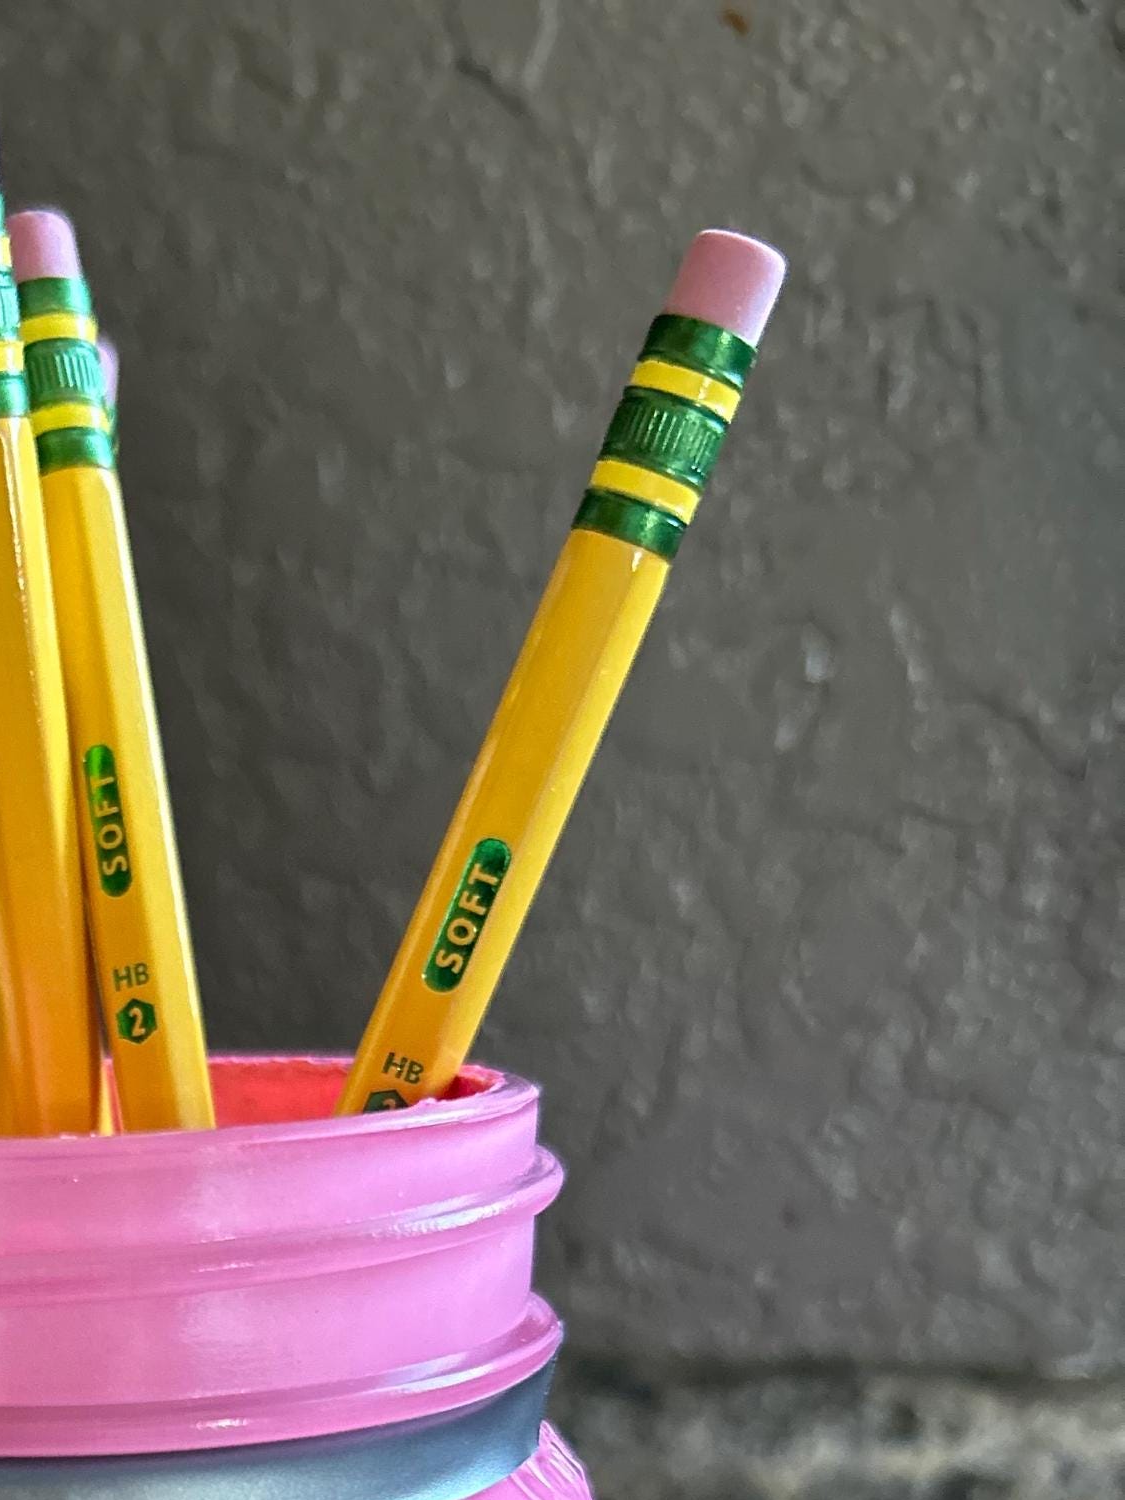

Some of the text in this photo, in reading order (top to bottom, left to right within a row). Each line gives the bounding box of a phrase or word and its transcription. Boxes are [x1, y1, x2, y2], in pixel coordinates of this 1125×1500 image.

[89, 773, 128, 877] SOFT
[436, 862, 500, 974] SOFT
[112, 962, 150, 992] HB
[128, 1006, 147, 1038] 2
[382, 1052, 425, 1084] HB
